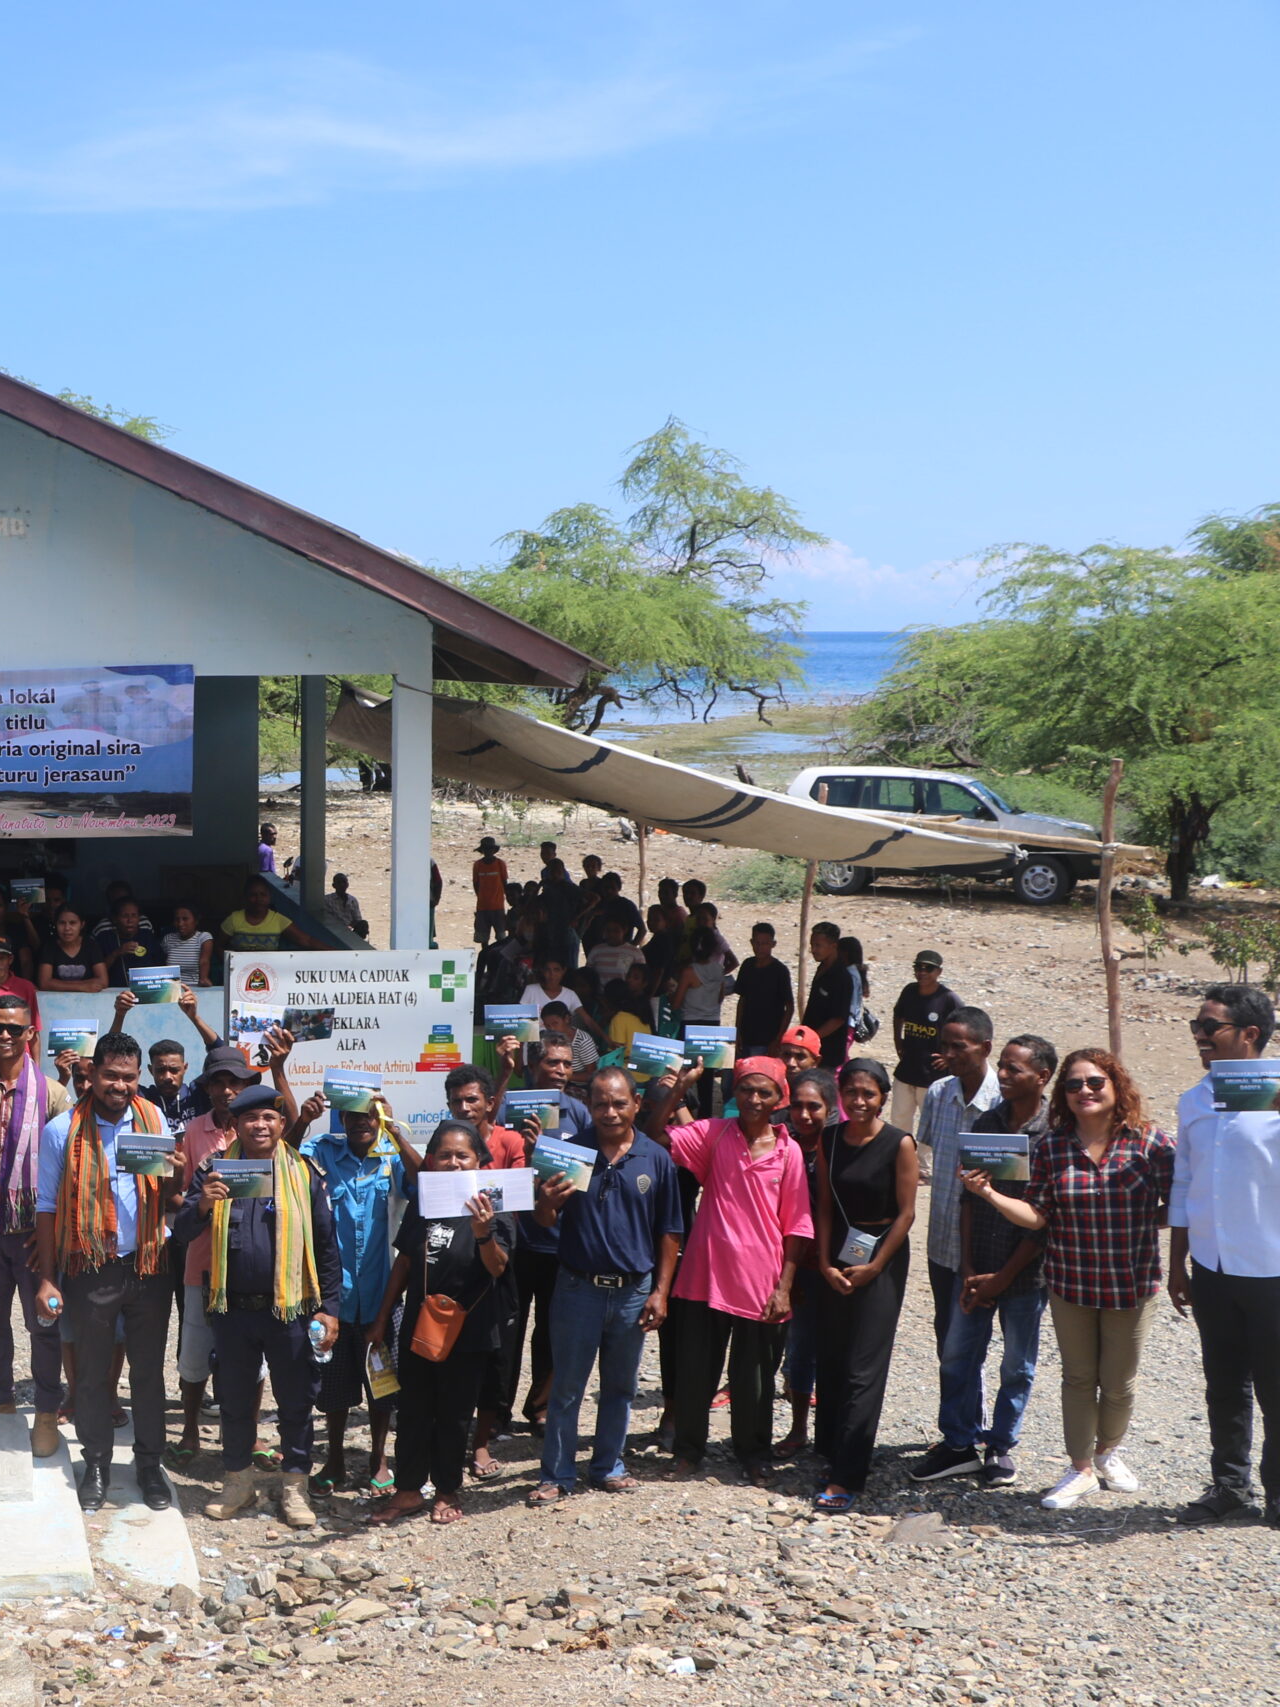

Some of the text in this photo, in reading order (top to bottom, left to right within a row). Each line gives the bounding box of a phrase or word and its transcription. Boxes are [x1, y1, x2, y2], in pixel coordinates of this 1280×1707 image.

[10, 688, 56, 705] lokál
[6, 714, 45, 730] titlu
[29, 740, 101, 761] original
[107, 739, 141, 755] sira
[44, 765, 136, 787] jerasaun”
[55, 815, 73, 830] 30
[78, 811, 137, 830] Novembru
[141, 813, 177, 828] 2023
[295, 969, 410, 984] SUKU UMA CADUAK
[287, 991, 418, 1007] HO NIA ALDEIA HAT (4)
[333, 1016, 380, 1030] EKLARA
[336, 1038, 367, 1051] ALFA
[408, 1109, 445, 1124] unicef
